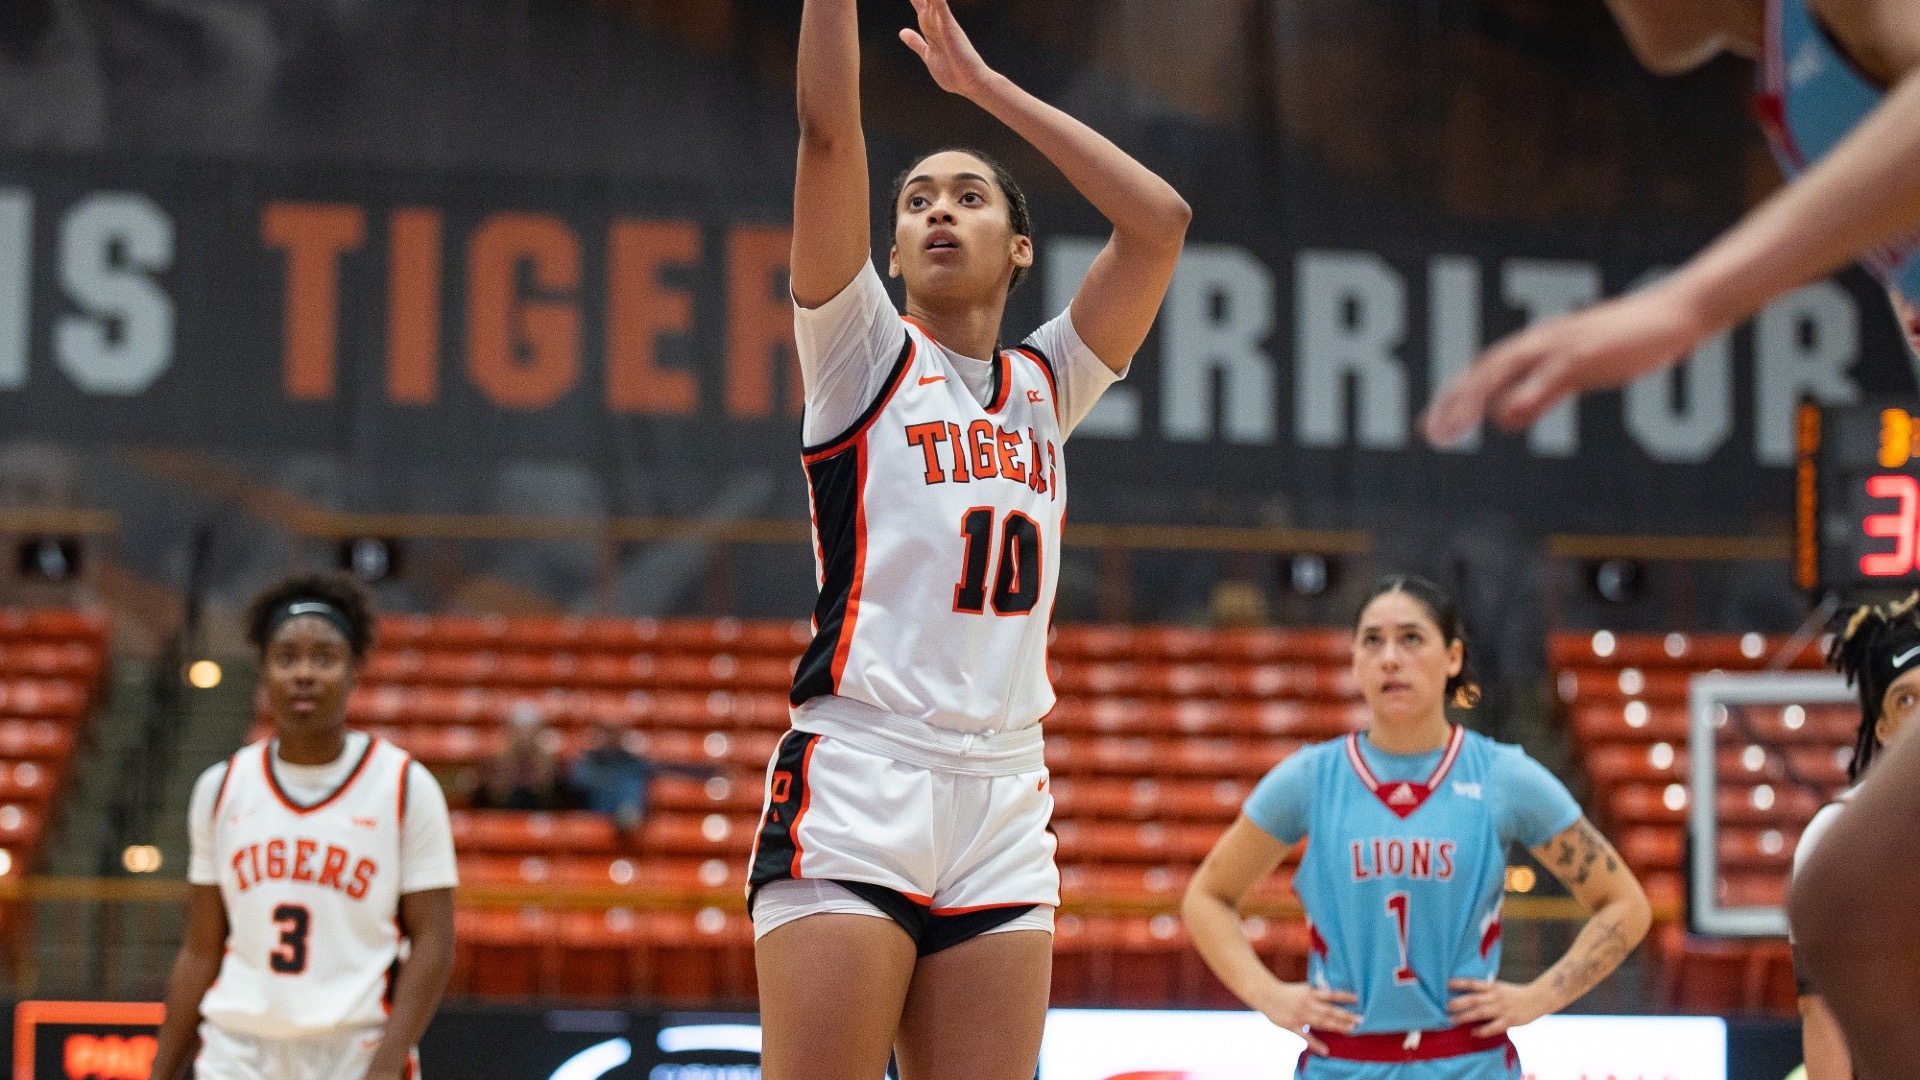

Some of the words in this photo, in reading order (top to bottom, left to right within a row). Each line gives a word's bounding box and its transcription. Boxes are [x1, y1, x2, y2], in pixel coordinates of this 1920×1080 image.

[952, 506, 1042, 616] 10
[1859, 474, 1920, 576] 3
[231, 838, 379, 900] TIGERS
[1350, 837, 1456, 882] LIONS
[269, 903, 312, 975] 3
[1385, 890, 1420, 986] 1
